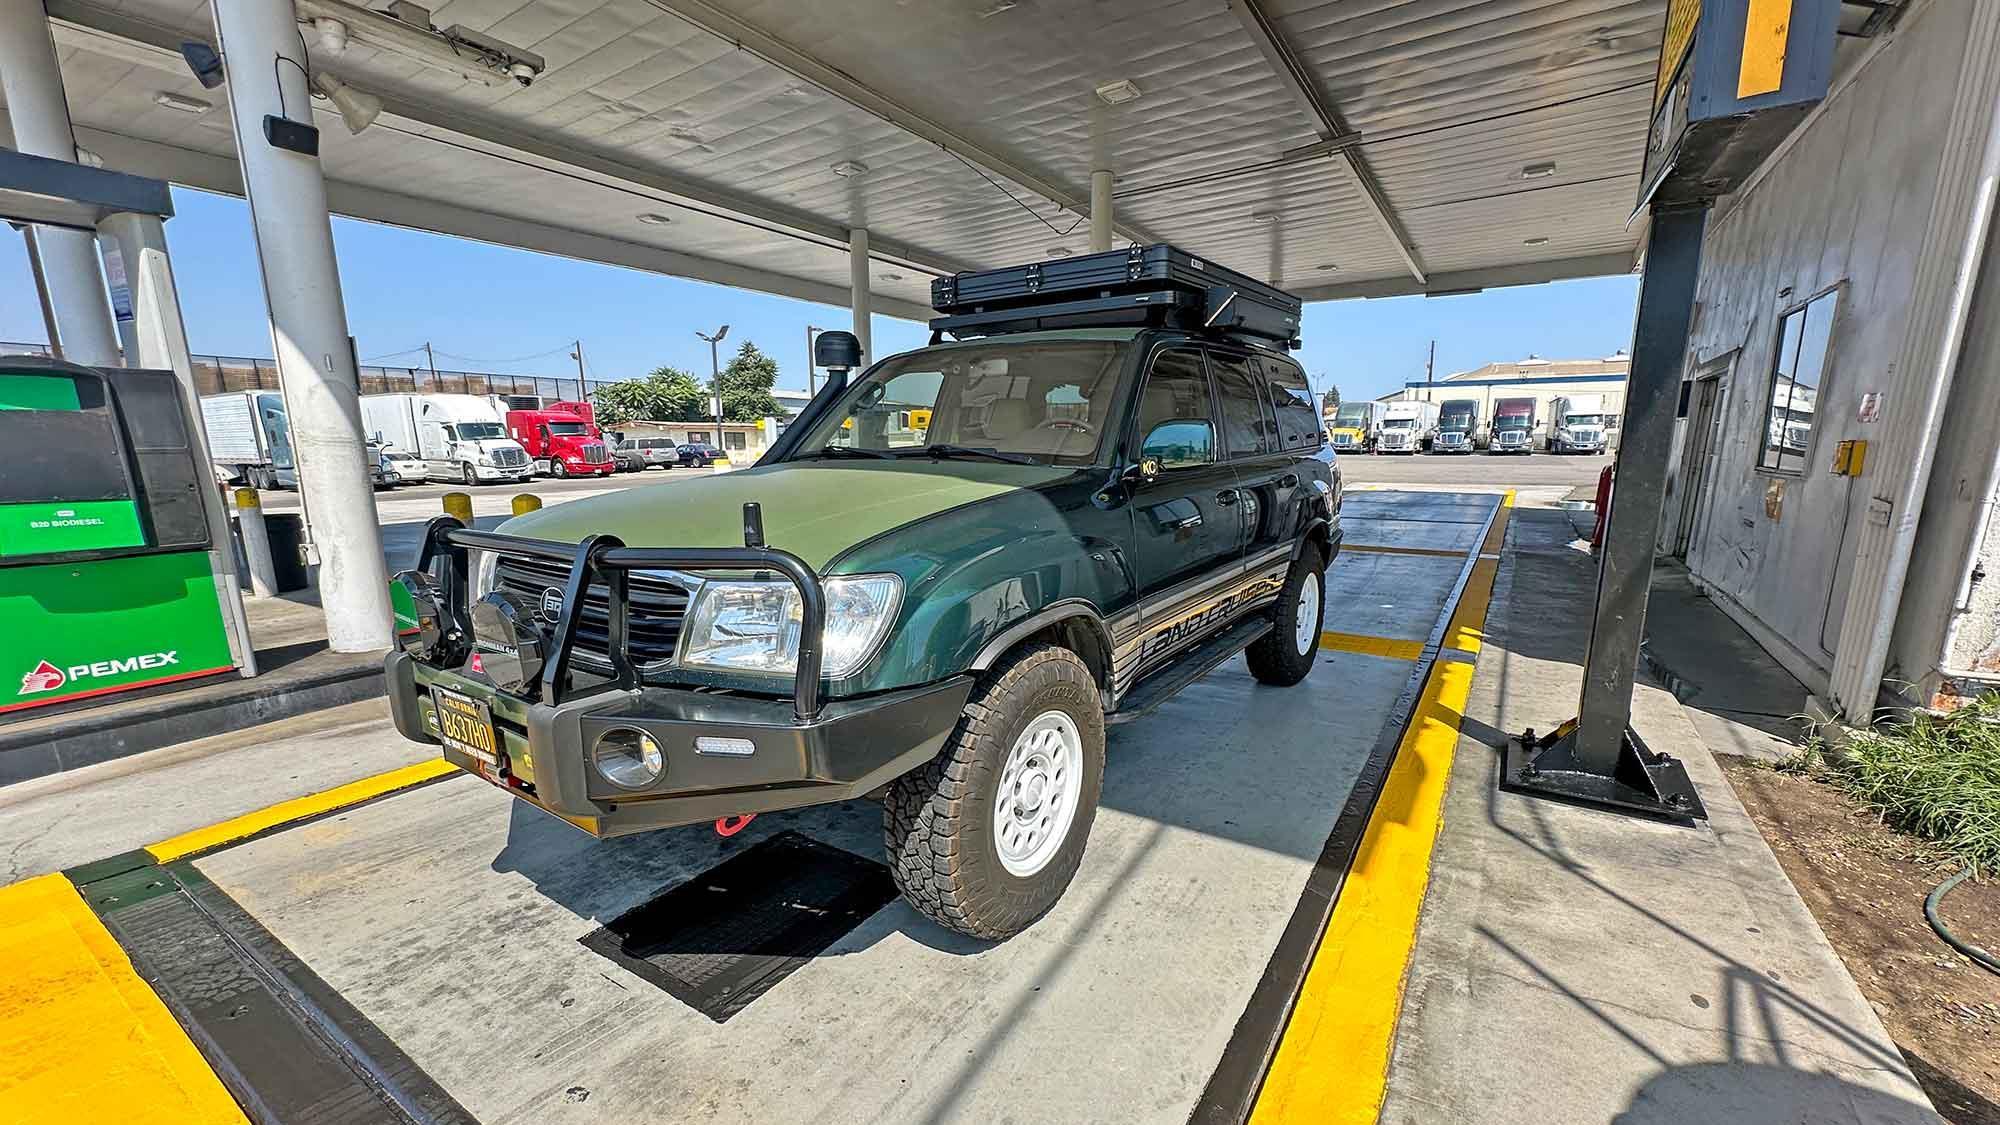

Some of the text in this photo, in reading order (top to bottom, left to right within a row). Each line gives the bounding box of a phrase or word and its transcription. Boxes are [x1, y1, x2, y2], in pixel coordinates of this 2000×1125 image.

[1142, 460, 1156, 475] KC
[52, 518, 105, 527] BIODIESEL
[68, 650, 180, 682] PEMEX
